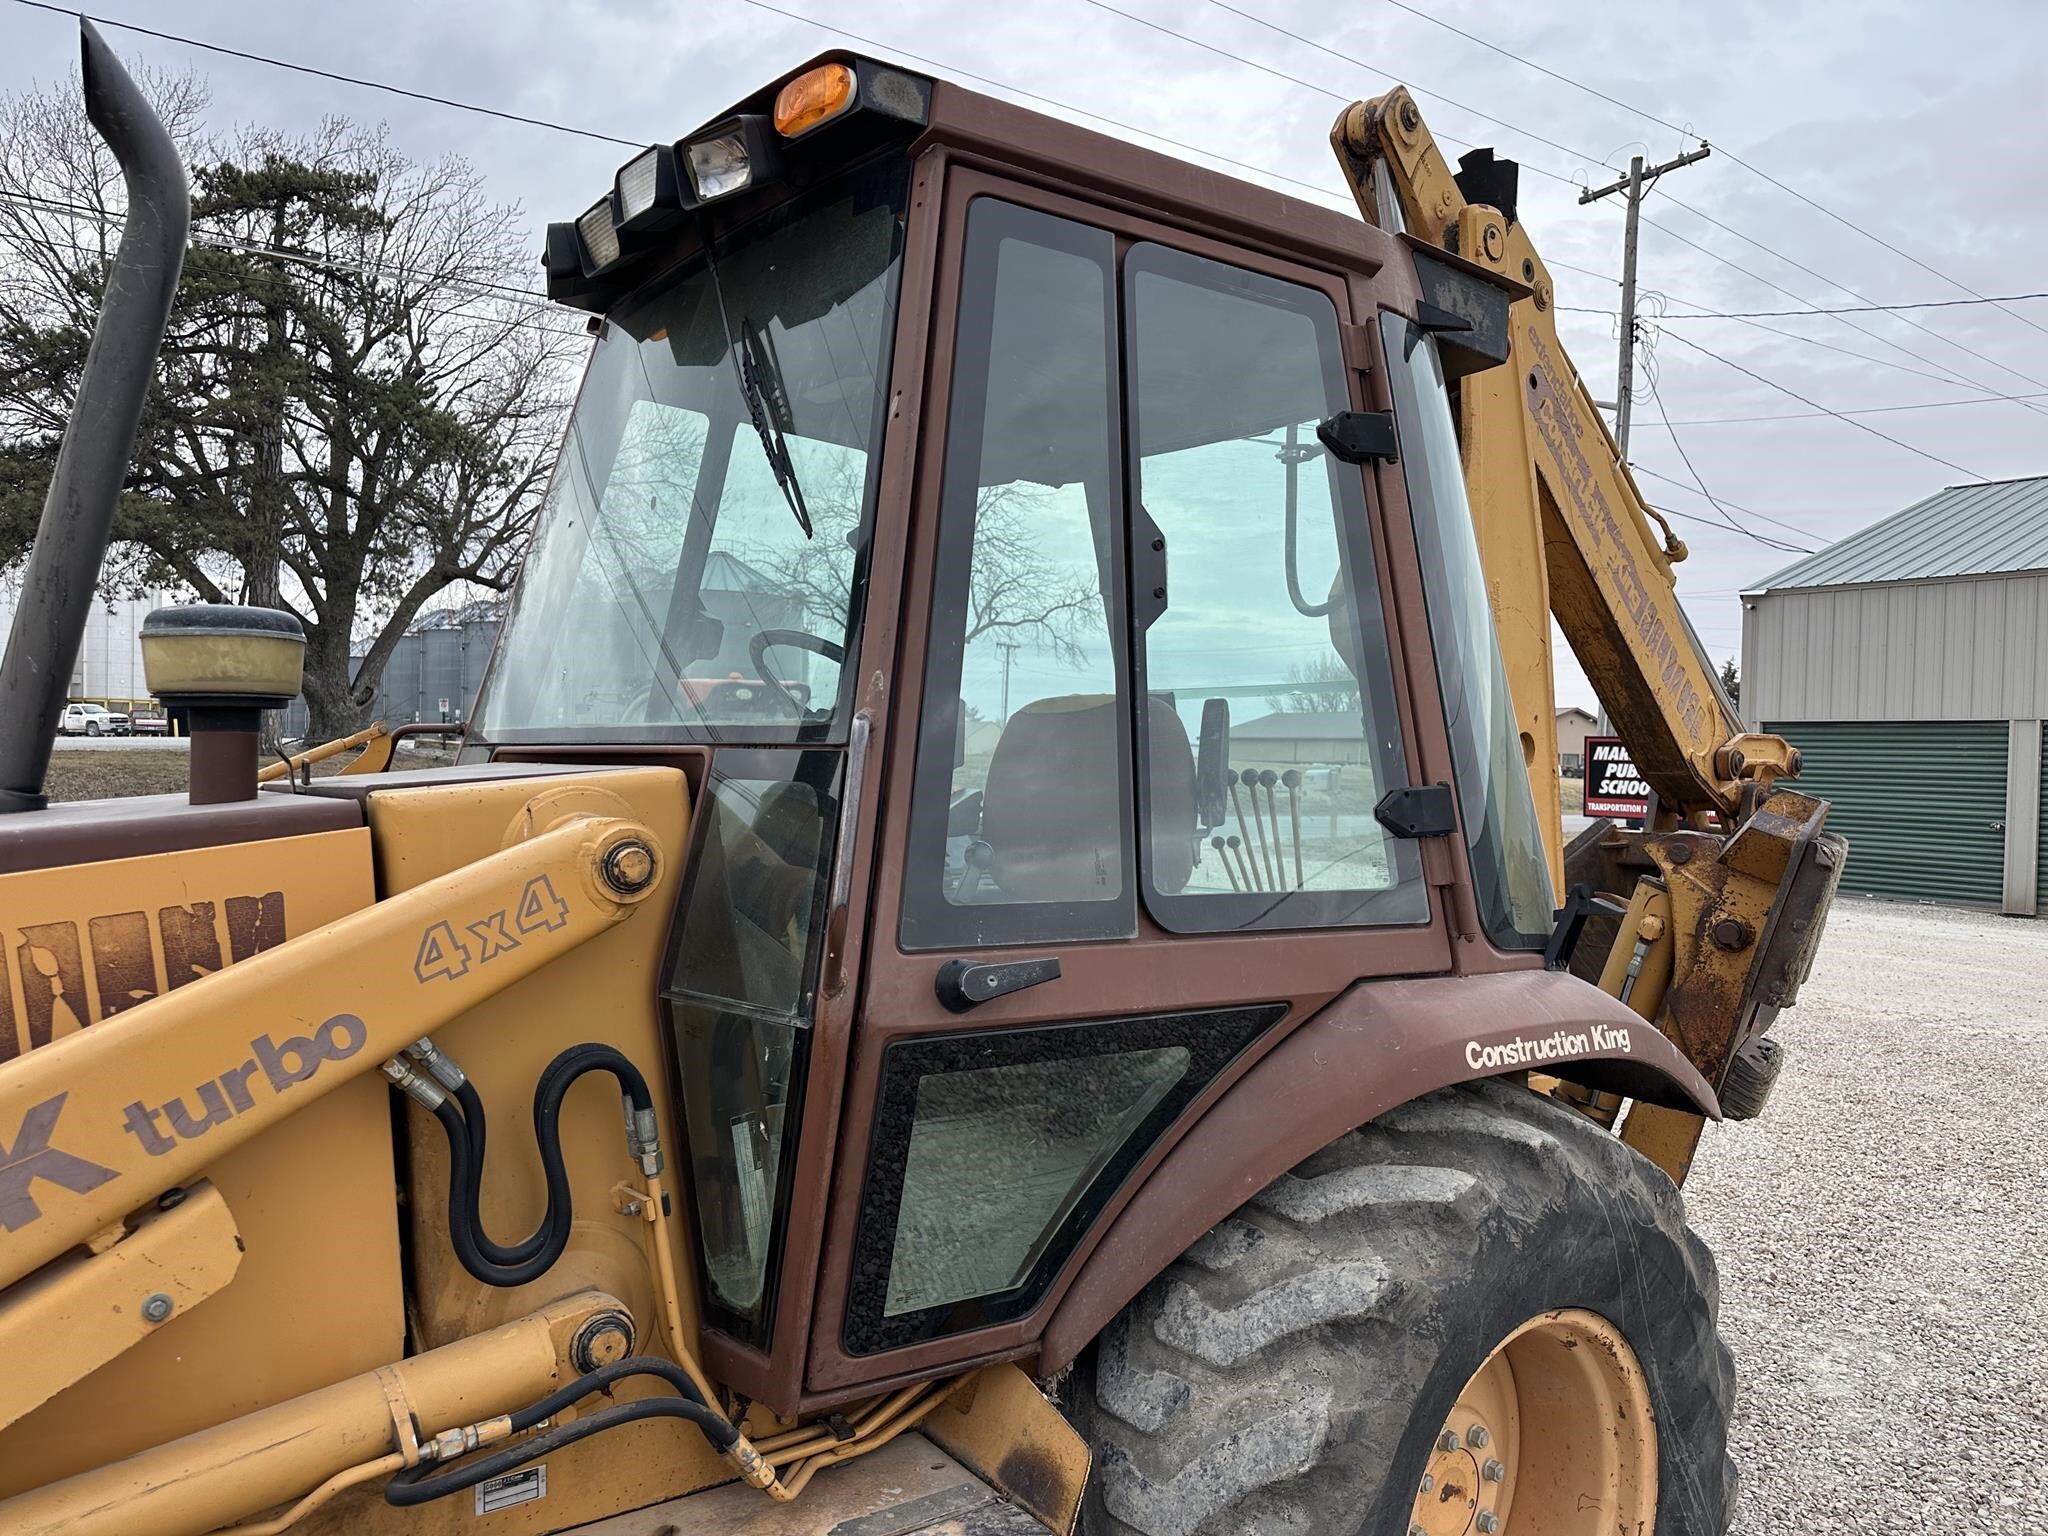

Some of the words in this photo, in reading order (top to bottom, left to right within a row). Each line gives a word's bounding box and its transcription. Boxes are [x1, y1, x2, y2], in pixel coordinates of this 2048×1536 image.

[1605, 763, 1641, 778] PUB
[1588, 802, 1641, 813] TRANSPORTATION
[122, 1013, 367, 1157] turbo
[414, 874, 568, 984] 4x4
[1465, 1031, 1589, 1070] Construction
[1590, 1024, 1631, 1053] King
